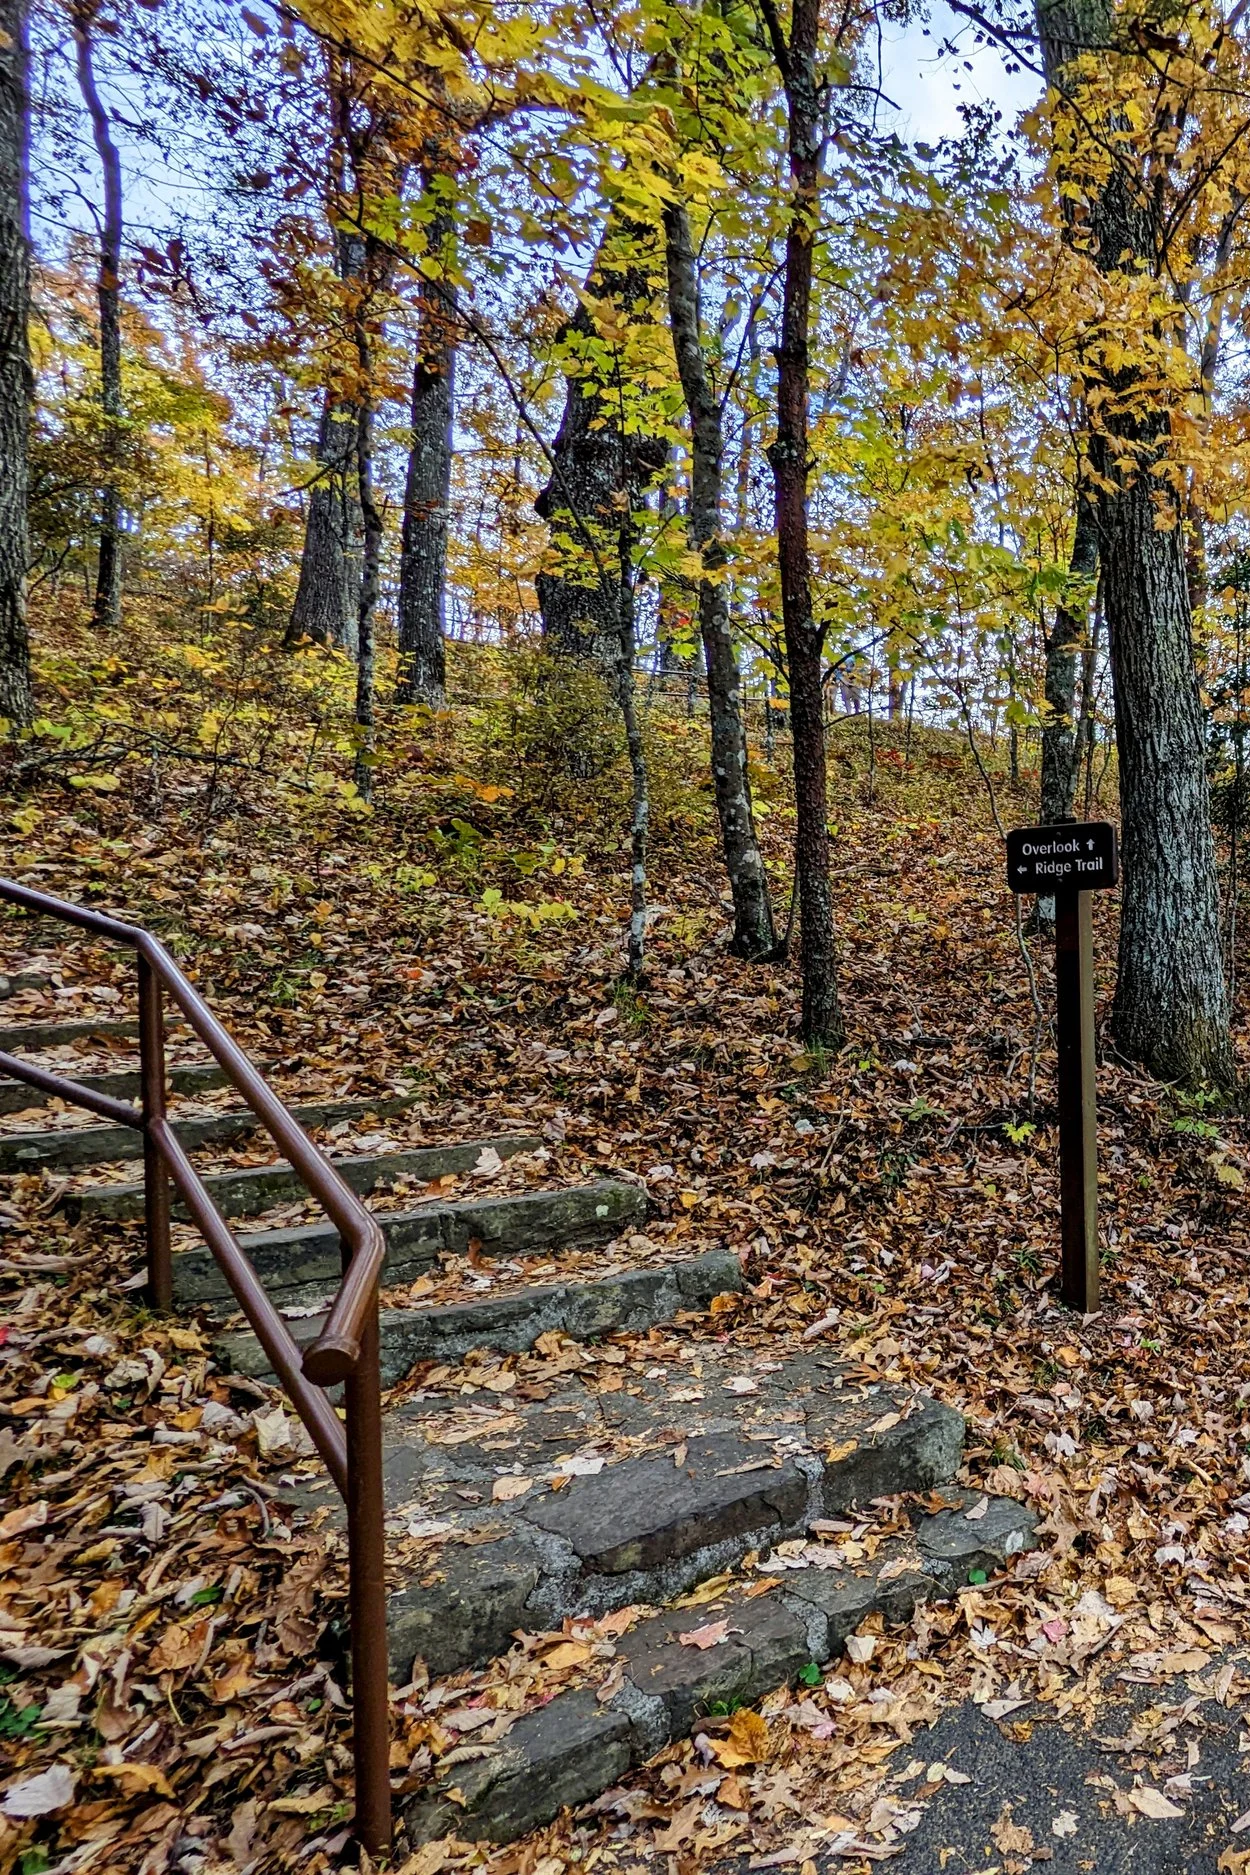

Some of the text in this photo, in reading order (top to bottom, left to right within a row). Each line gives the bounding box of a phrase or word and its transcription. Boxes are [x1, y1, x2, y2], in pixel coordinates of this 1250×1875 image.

[1022, 839, 1080, 855] Overlook
[1035, 857, 1103, 876] Ridge Trail
